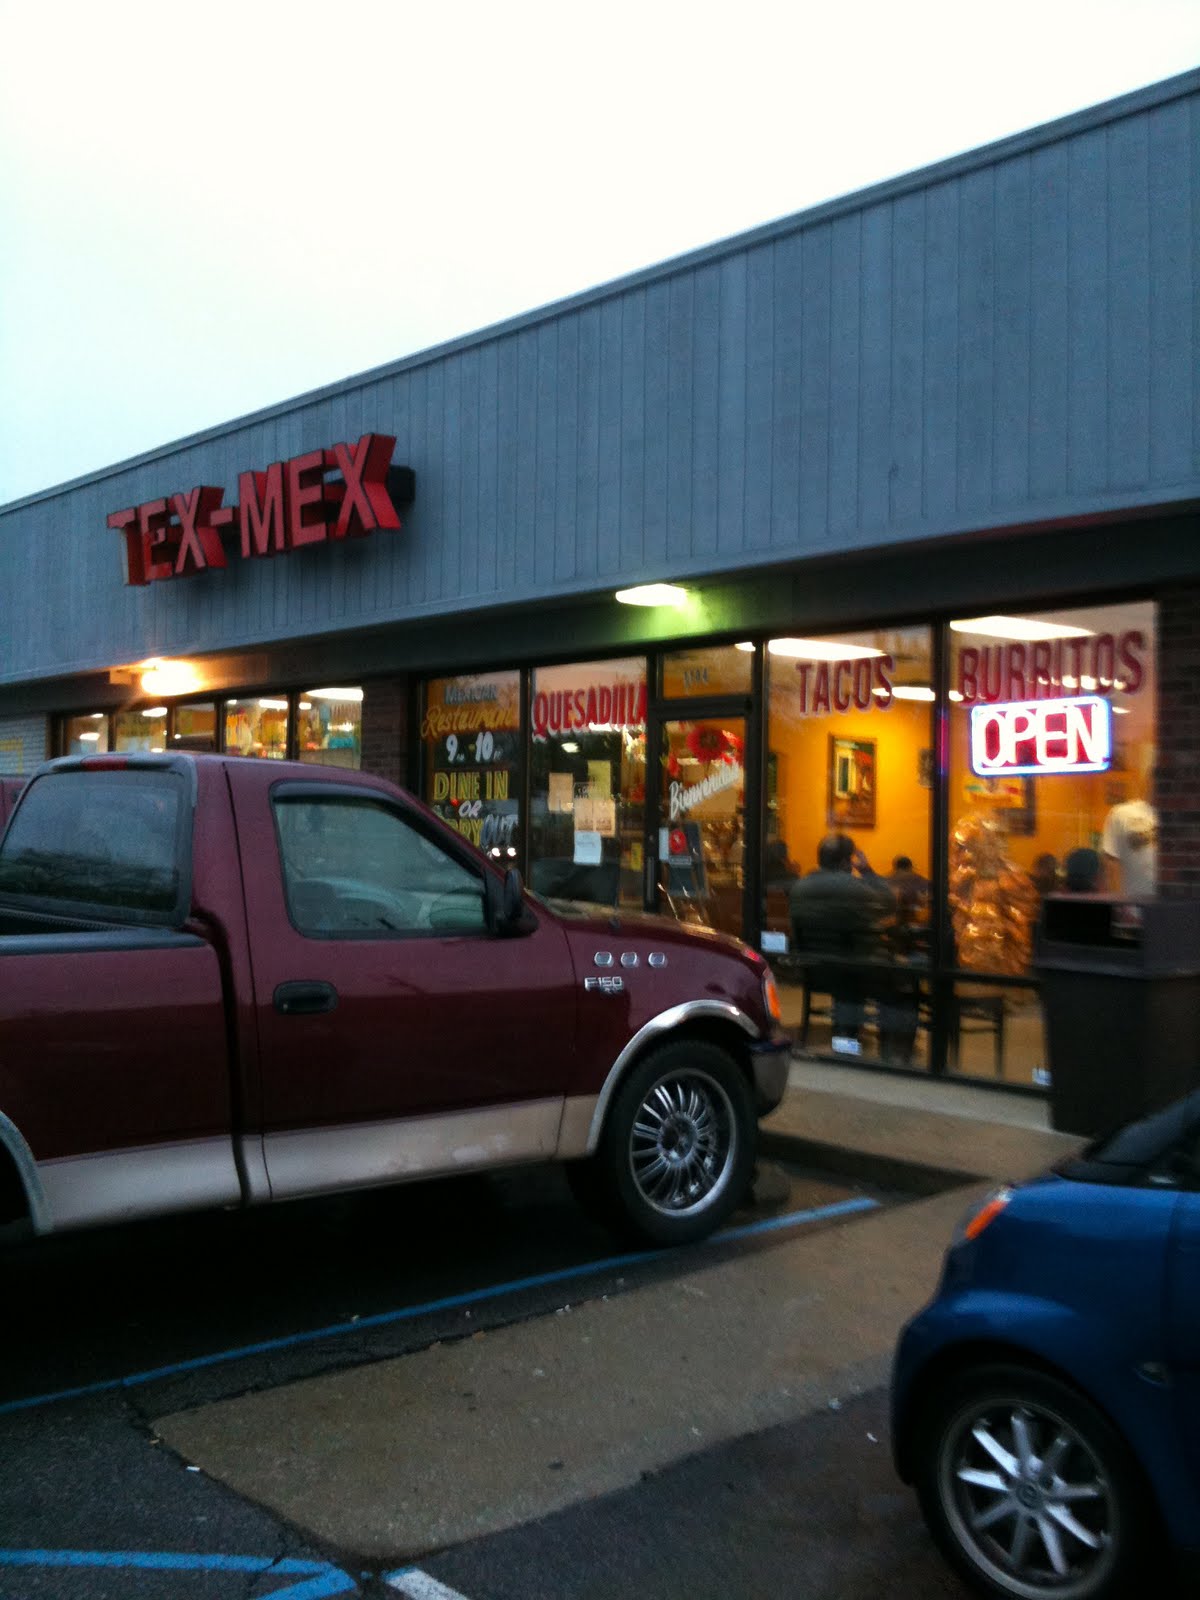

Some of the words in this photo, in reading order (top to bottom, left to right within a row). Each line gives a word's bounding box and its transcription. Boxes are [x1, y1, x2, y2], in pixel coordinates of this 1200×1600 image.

[107, 432, 400, 586] TEX-MEX
[796, 655, 895, 717] TACOS
[959, 630, 1142, 707] BURRITOS
[979, 704, 1109, 767] OPEN
[434, 772, 480, 801] DINE
[486, 770, 509, 800] IN
[459, 799, 482, 818] OR
